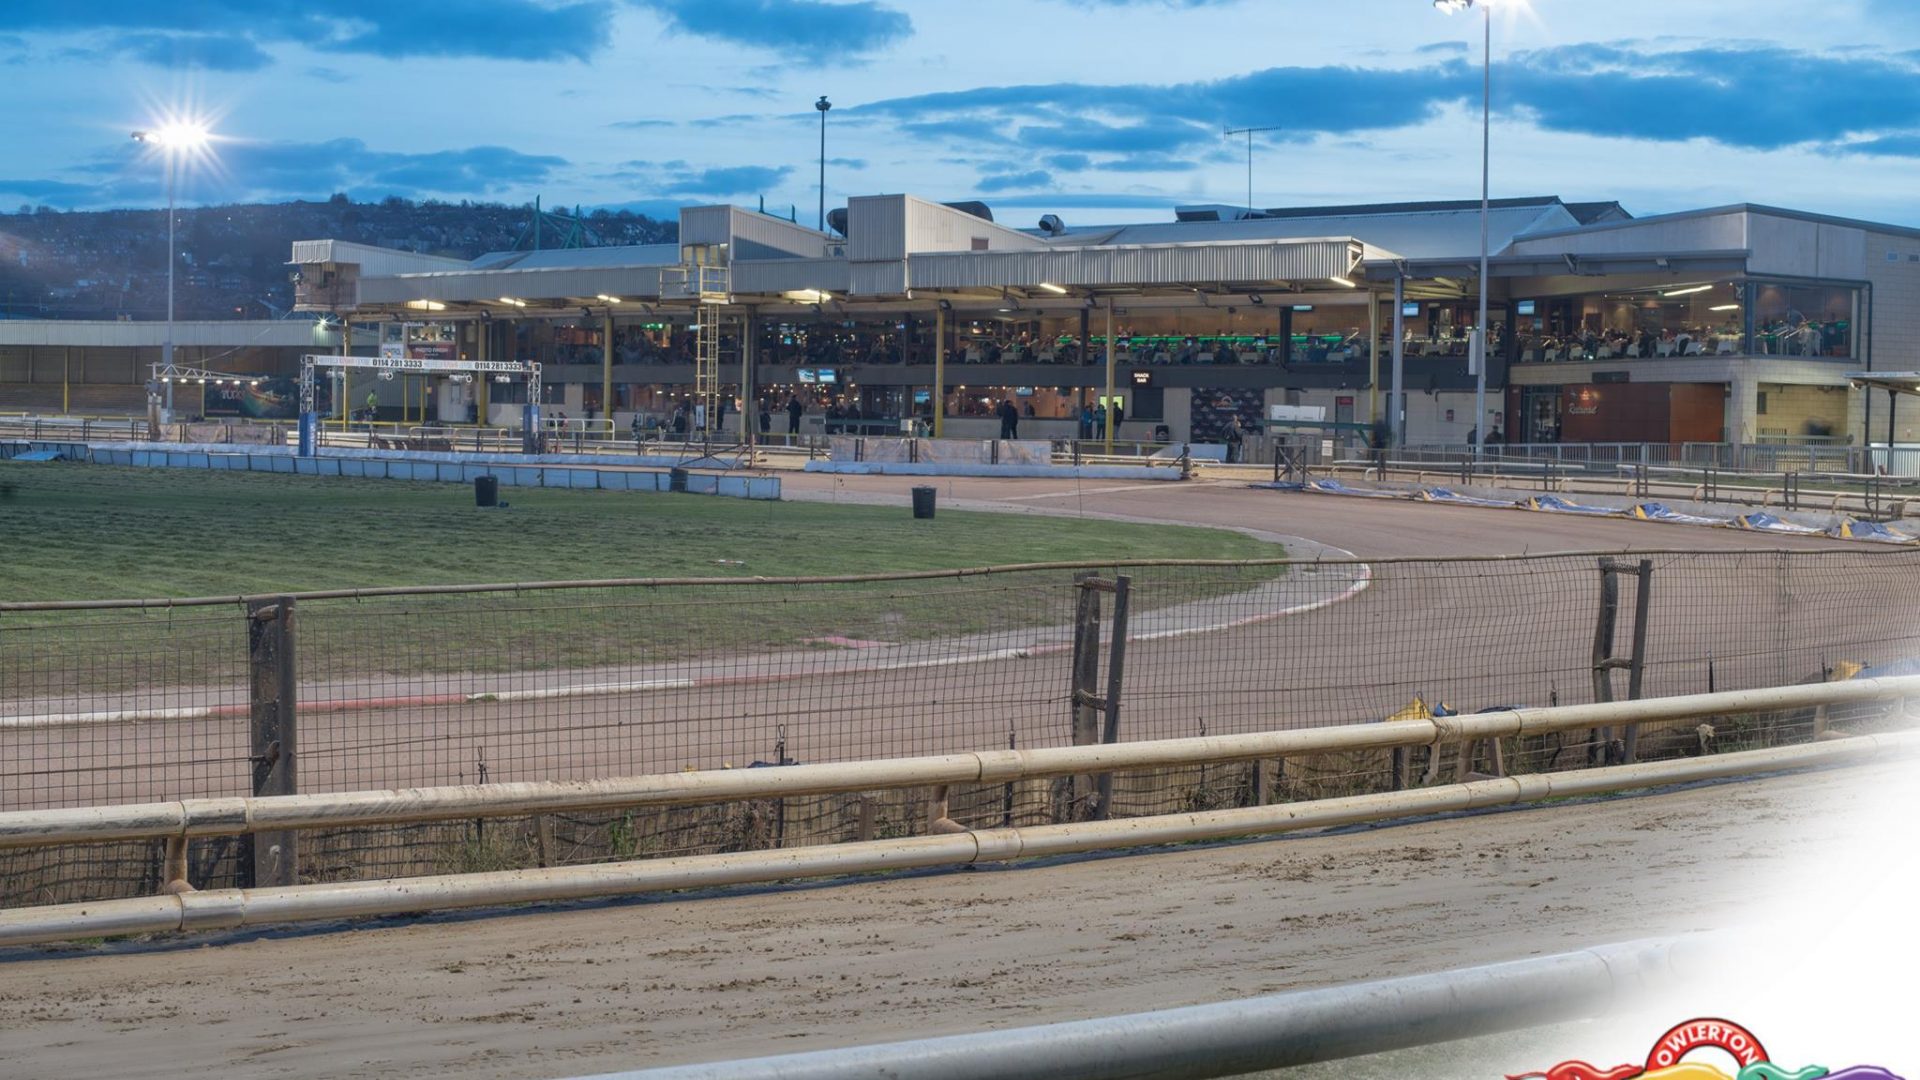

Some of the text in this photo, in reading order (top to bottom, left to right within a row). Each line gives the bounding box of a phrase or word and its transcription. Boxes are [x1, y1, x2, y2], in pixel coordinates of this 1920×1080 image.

[390, 359, 403, 367] 281
[404, 360, 423, 368] 3333
[474, 361, 490, 369] 0114
[491, 362, 504, 370] 281
[503, 362, 522, 370] 3333
